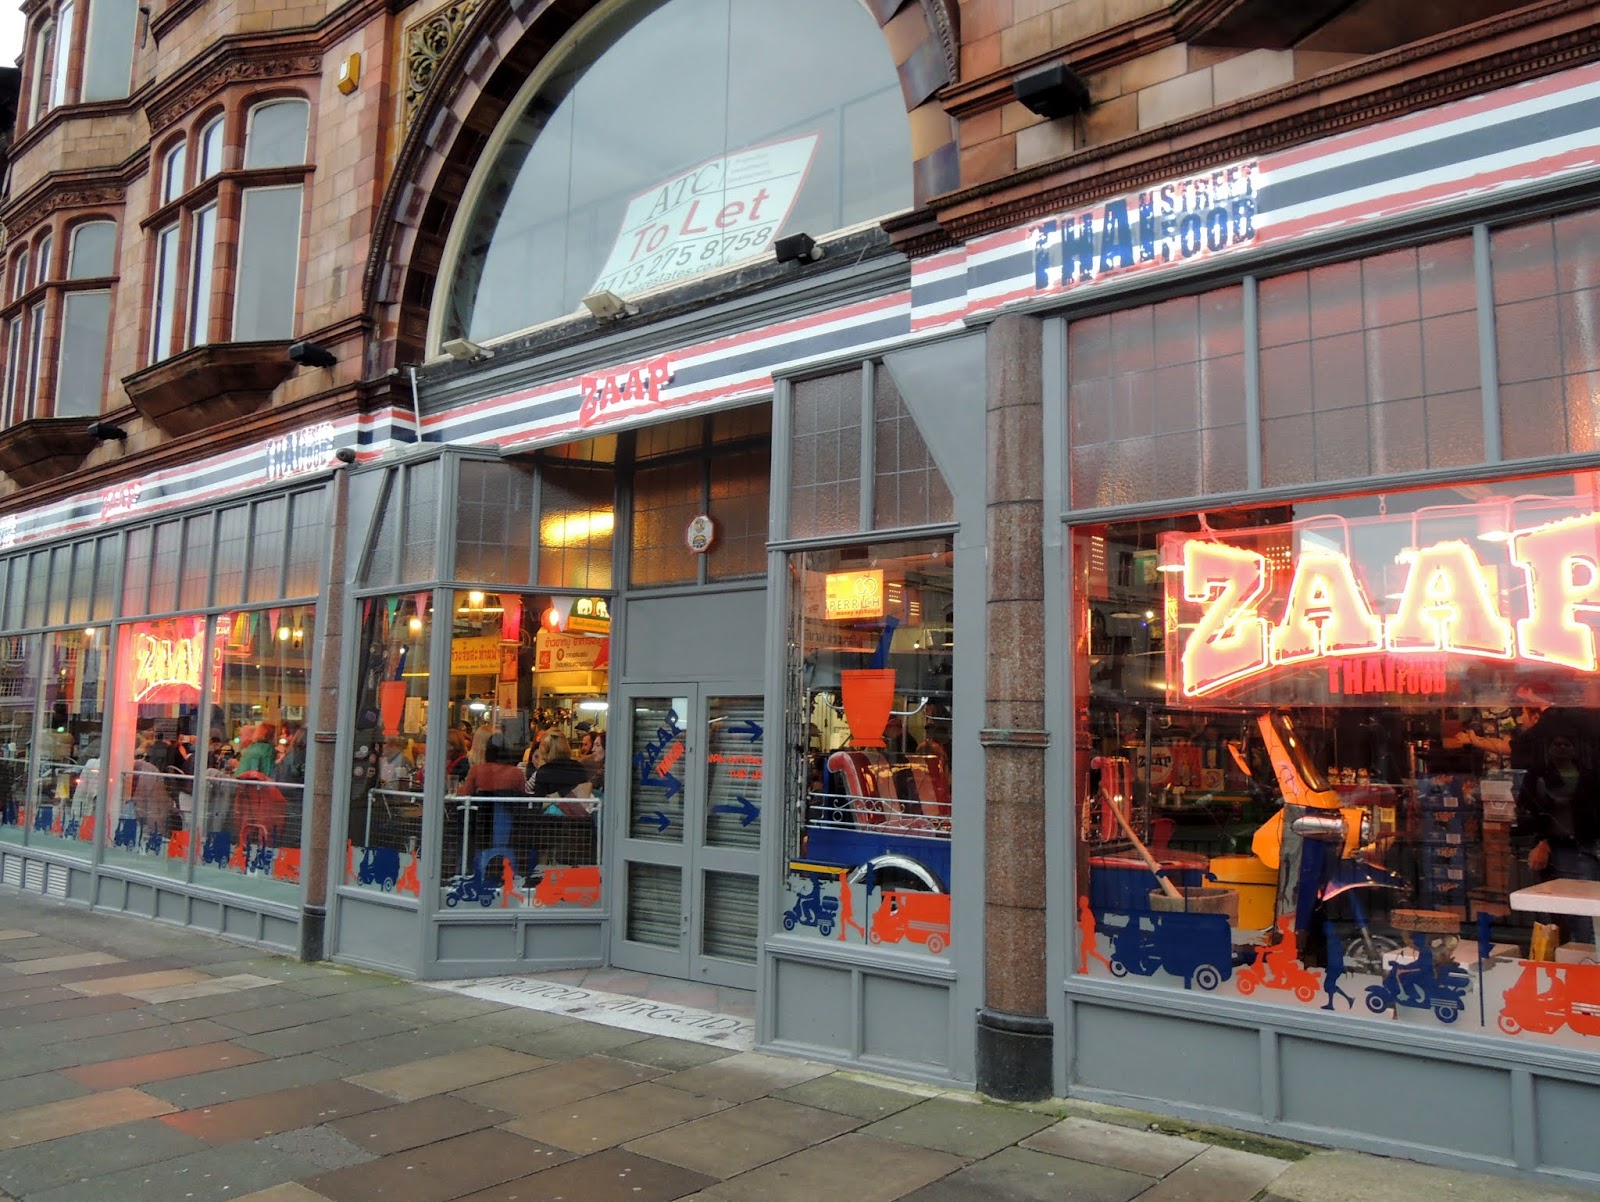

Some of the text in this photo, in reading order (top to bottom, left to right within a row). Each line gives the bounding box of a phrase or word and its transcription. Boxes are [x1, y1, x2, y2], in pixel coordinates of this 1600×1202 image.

[646, 164, 719, 220] ATC
[630, 188, 769, 262] To Let
[647, 245, 695, 276] 275
[700, 227, 772, 260] 8758
[579, 357, 670, 427] ZAAP
[1182, 511, 1600, 697] ZAAP
[1327, 656, 1395, 694] THAI
[1397, 670, 1446, 694] FOOD
[632, 708, 682, 779] ZAAP
[1138, 753, 1171, 768] ZAP
